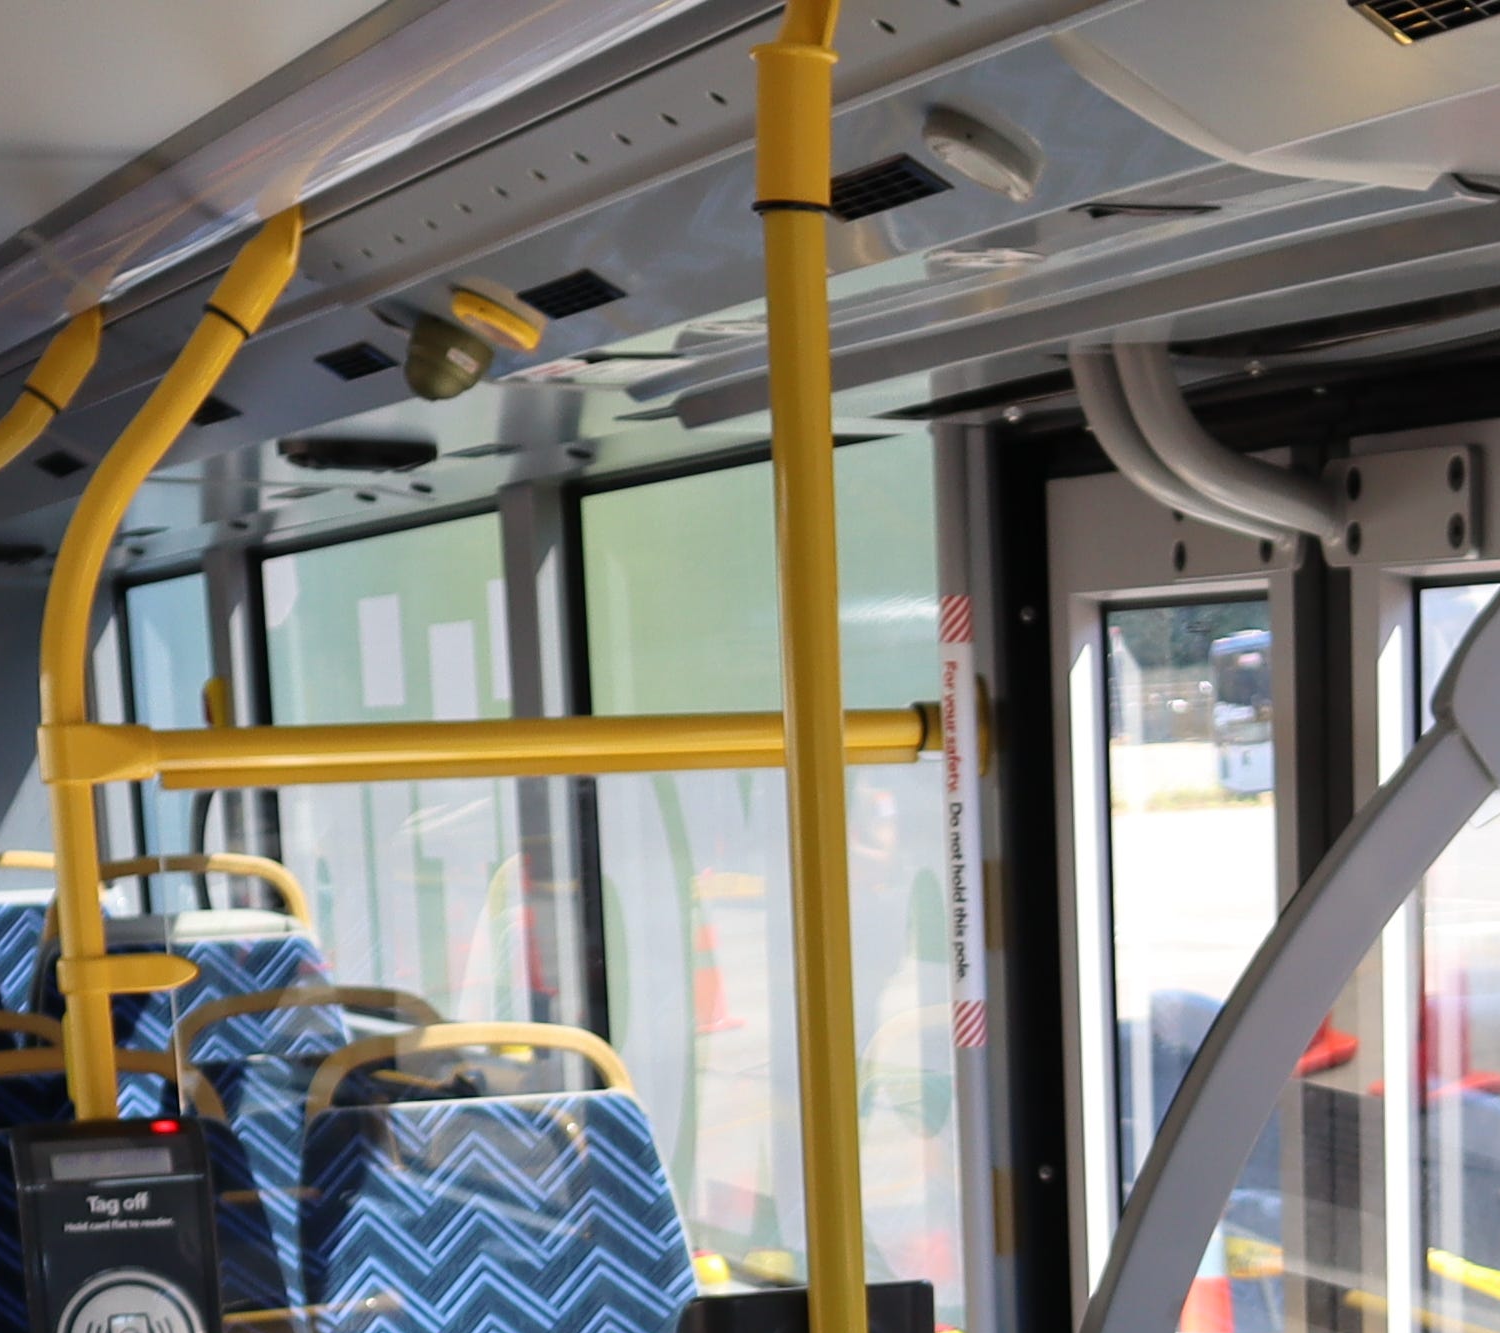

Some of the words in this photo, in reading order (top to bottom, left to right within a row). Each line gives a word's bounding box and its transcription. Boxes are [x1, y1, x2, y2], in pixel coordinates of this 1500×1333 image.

[944, 660, 959, 688] For
[945, 693, 960, 732] your
[949, 802, 963, 827] Do
[951, 832, 965, 861] not
[953, 864, 967, 903] hold
[954, 907, 968, 937] this
[86, 1195, 120, 1216] Tag
[123, 1191, 149, 1210] off
